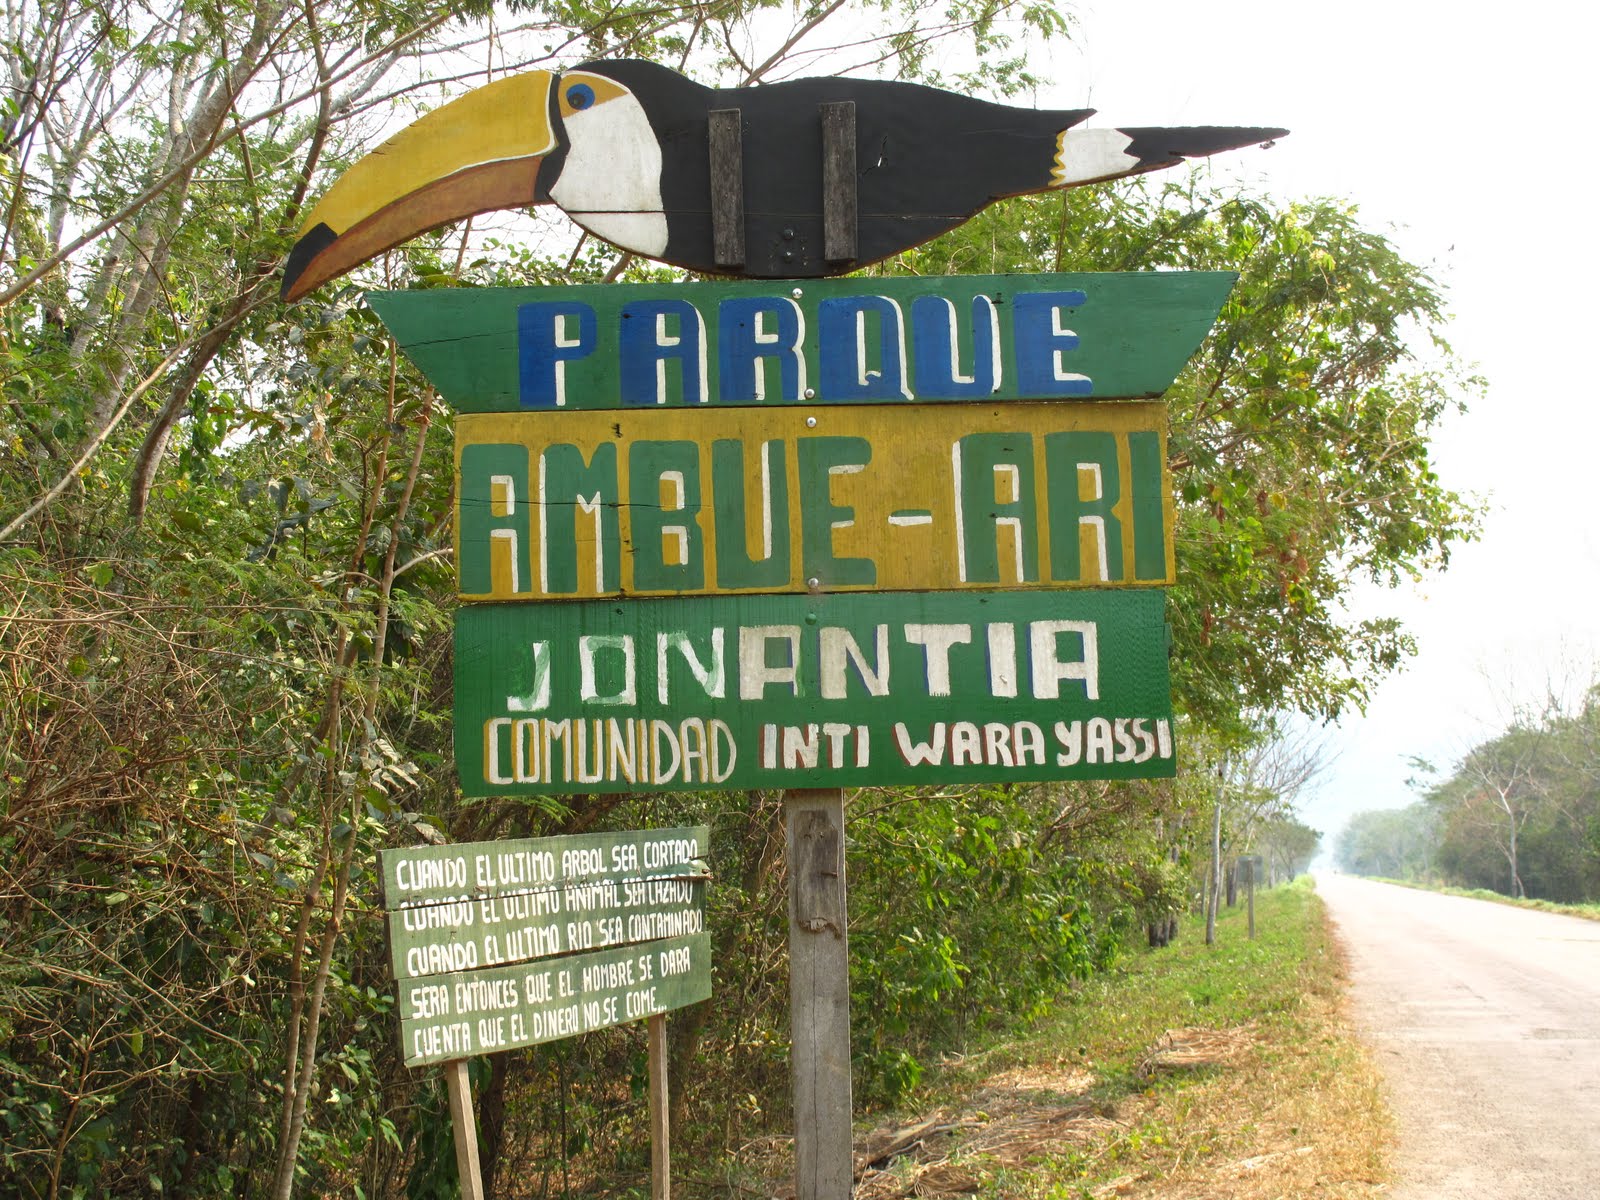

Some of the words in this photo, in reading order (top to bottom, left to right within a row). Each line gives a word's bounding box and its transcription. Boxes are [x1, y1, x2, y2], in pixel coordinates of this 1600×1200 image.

[519, 291, 1093, 406] PARQUE
[459, 431, 1166, 595] AMBUE-ARI
[483, 717, 737, 785] COMUNIDAD
[759, 721, 869, 769] INTI
[396, 857, 467, 891] CUANDO
[475, 855, 497, 887] EL
[498, 851, 555, 885] ULTIMO
[562, 848, 607, 877] ARBOL
[612, 844, 637, 872] SEA
[644, 839, 698, 869] CORTADO
[400, 895, 474, 931] CUANDO
[479, 893, 500, 923] EL
[501, 886, 560, 920] ULTIMO
[564, 879, 621, 911] ANIMAL
[407, 941, 478, 977] CUANDO
[484, 935, 505, 965] EL
[506, 924, 560, 961] ULTIMO
[567, 921, 592, 951] RIO
[599, 916, 623, 946] SEA
[628, 909, 703, 942] CONTAMINADO
[410, 984, 449, 1019] SERA
[455, 979, 519, 1015] ENTONCES
[526, 972, 552, 1005] QUE
[559, 970, 574, 997] EL
[583, 959, 635, 992] HOMBRE
[639, 954, 653, 981] SE
[660, 946, 691, 977] DARA
[414, 1022, 471, 1057] CUENTA
[479, 1016, 506, 1048] QUE
[511, 1013, 528, 1042] EL
[533, 1004, 579, 1039] DINERO
[583, 1000, 600, 1029] NO
[603, 996, 619, 1025] SE
